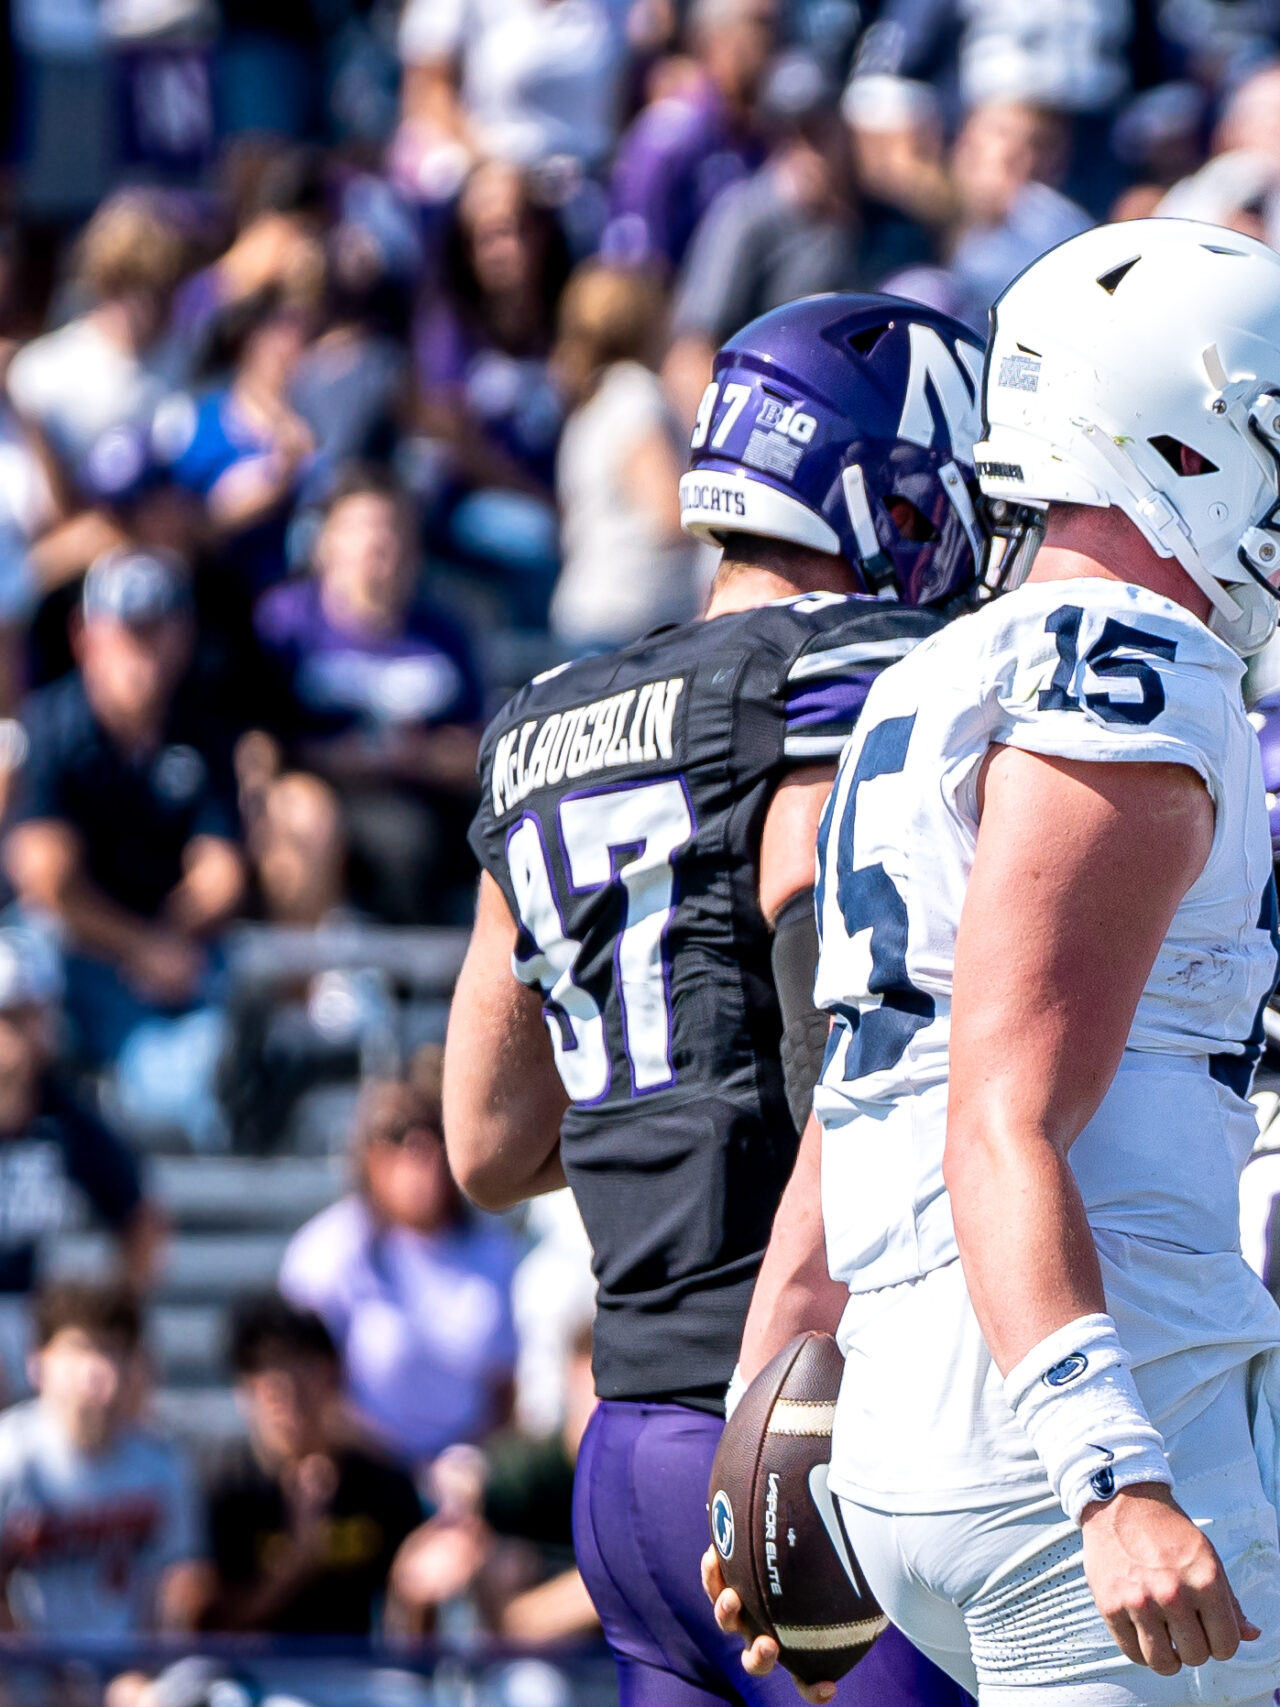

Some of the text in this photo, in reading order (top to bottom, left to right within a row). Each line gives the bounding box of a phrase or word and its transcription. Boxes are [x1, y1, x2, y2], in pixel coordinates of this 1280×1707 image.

[1037, 604, 1178, 726] 15
[765, 1472, 783, 1596] VAPOR ELITE
